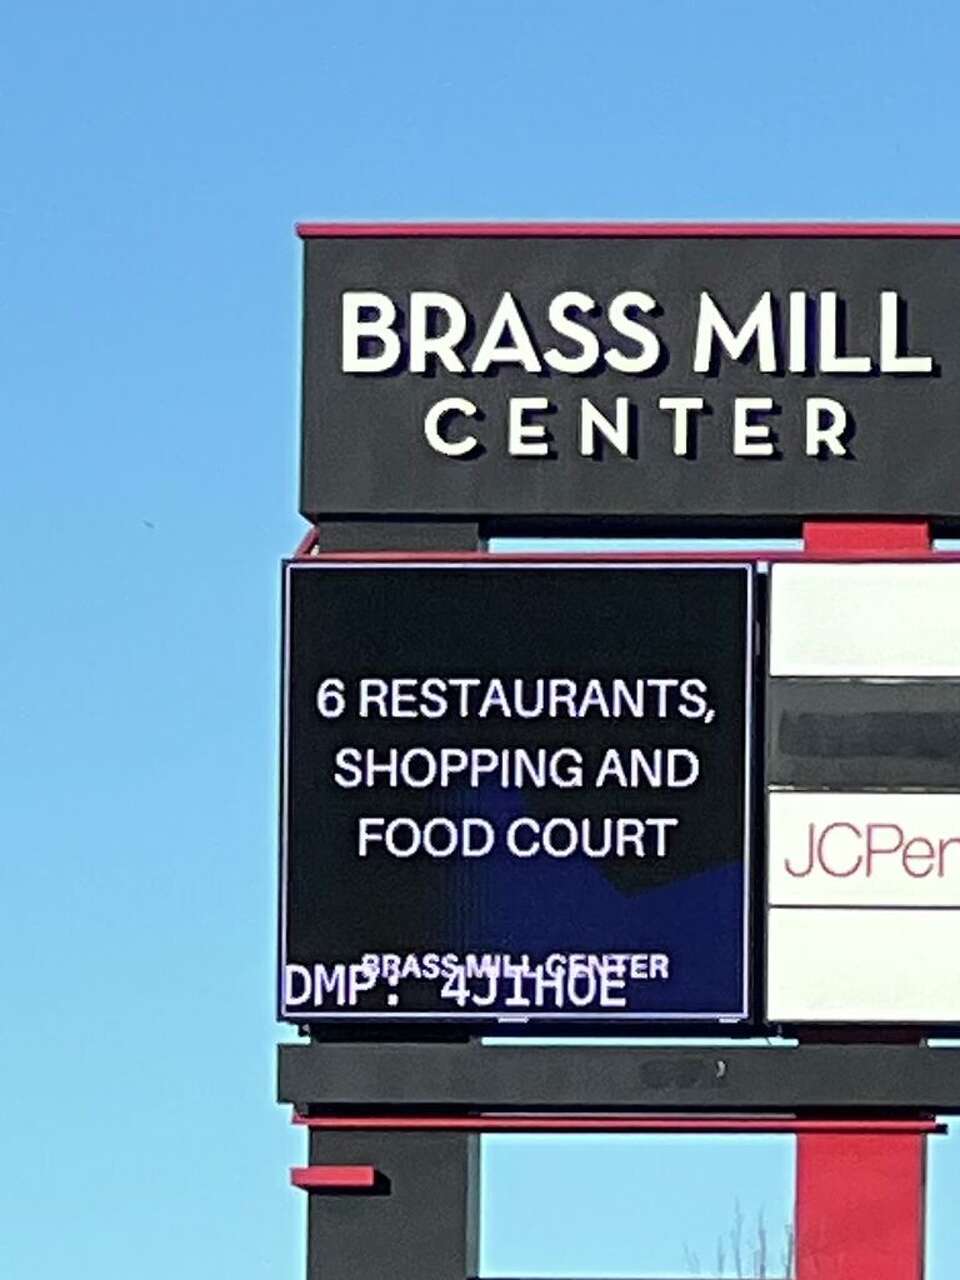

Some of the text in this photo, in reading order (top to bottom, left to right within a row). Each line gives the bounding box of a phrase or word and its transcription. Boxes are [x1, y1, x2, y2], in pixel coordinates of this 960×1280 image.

[341, 291, 932, 373] BRASS MILL
[424, 396, 848, 456] CENTER
[317, 678, 715, 723] 6 RESTAURANTS,
[334, 748, 700, 788] SHOPPING AND
[358, 817, 679, 857] FOOD COURT
[284, 963, 399, 1007] DMP:
[361, 953, 460, 979] BRASS
[545, 953, 670, 979] CENTER
